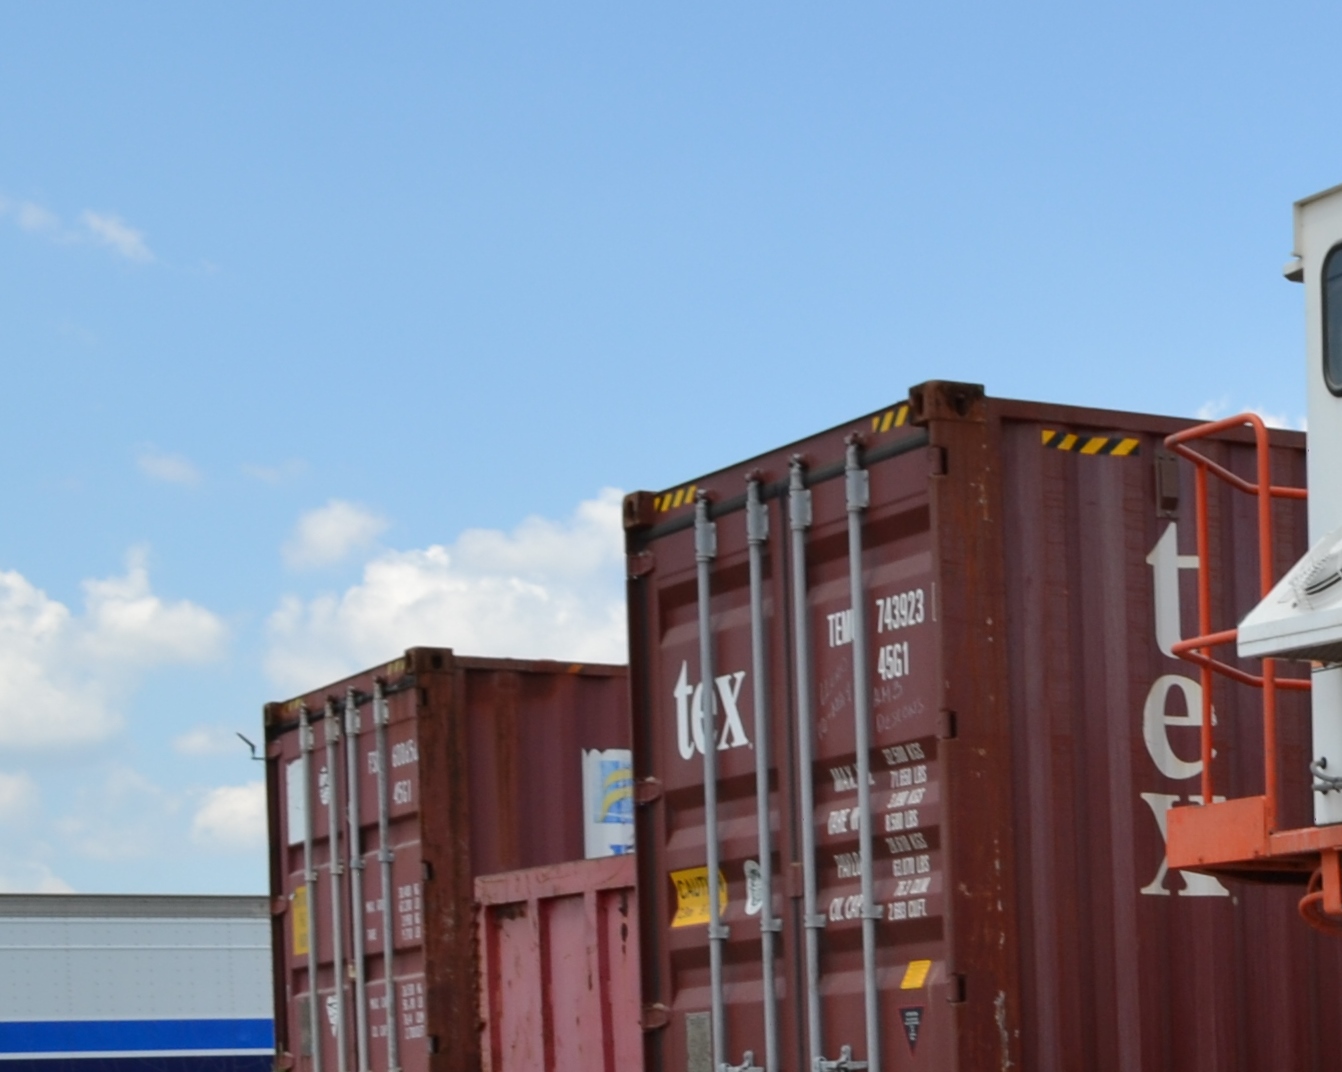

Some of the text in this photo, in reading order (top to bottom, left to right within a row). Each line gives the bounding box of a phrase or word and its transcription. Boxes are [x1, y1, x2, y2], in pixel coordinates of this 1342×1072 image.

[827, 588, 925, 648] TEM 743923
[877, 641, 909, 681] 45G1
[674, 660, 748, 760] tex
[676, 874, 725, 899] CAUTIN
